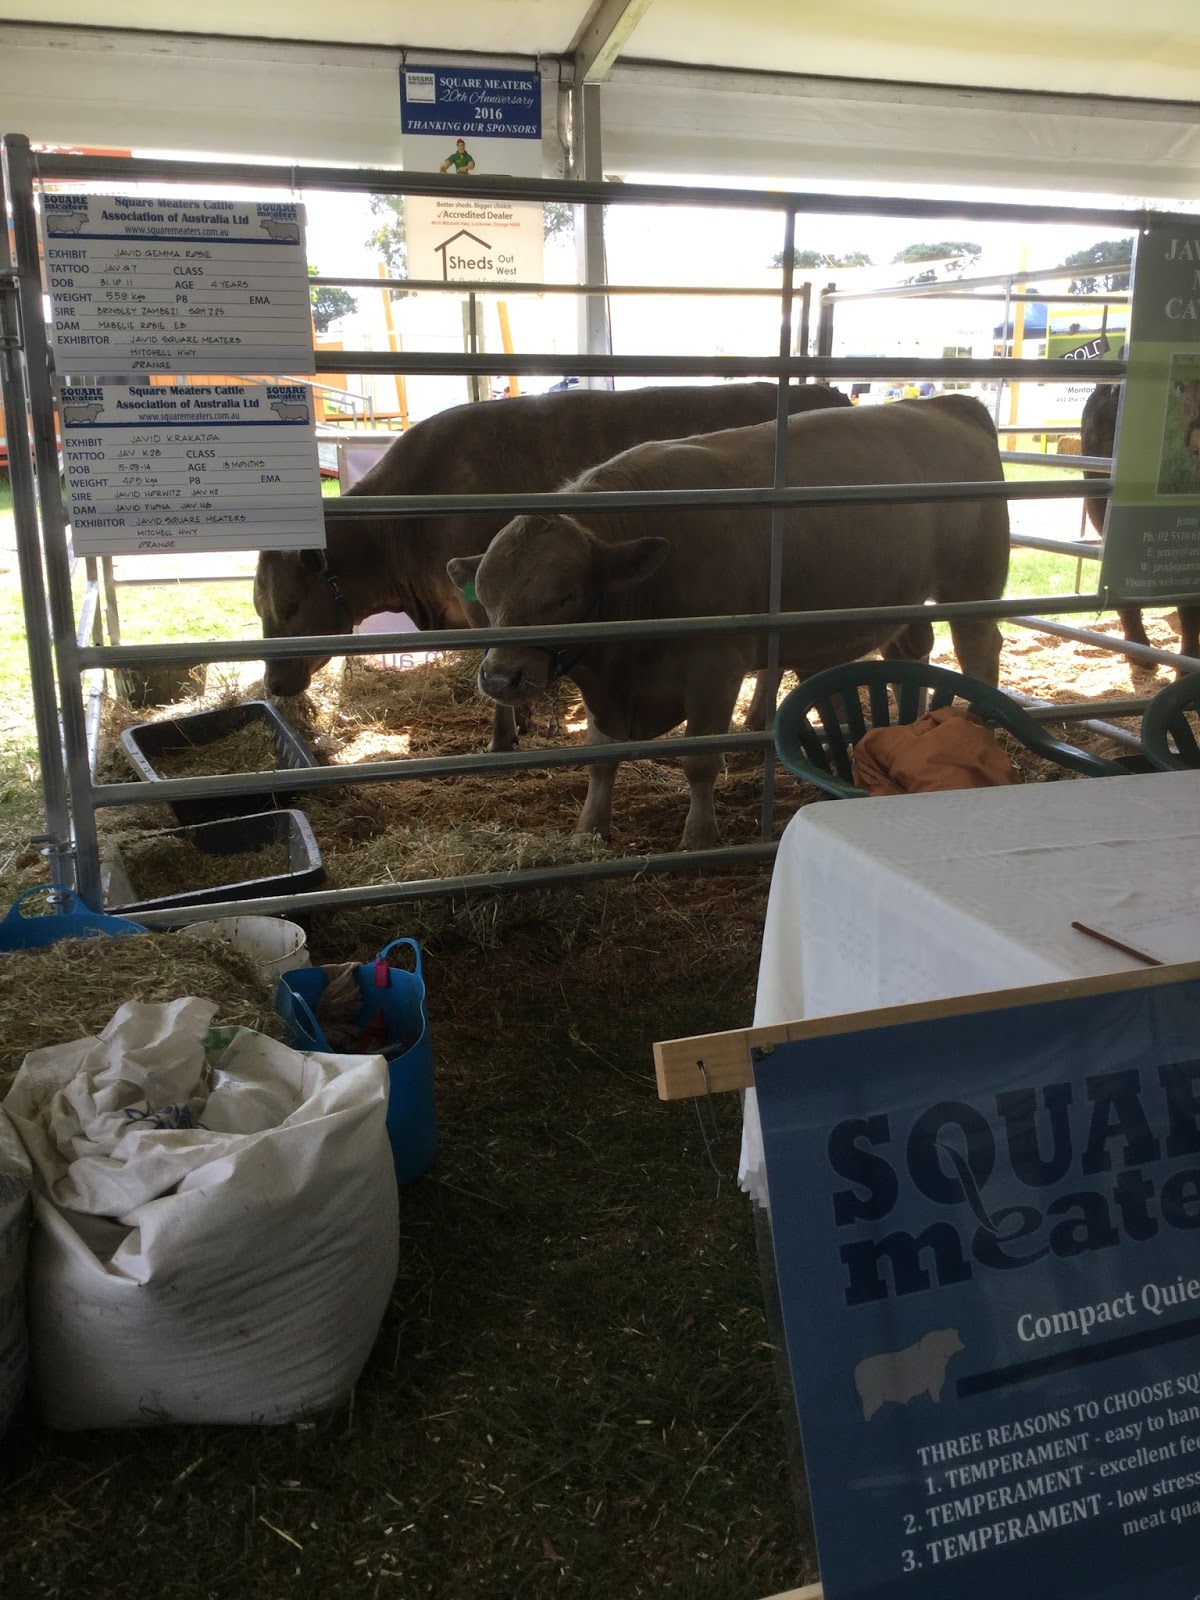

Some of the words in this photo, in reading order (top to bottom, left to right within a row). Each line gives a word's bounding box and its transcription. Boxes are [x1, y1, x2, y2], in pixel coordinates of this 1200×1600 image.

[440, 77, 482, 89] SQUARE
[484, 79, 533, 91] MEATERS
[439, 89, 468, 103] 20th
[469, 90, 534, 108] Anniversary
[474, 107, 503, 120] 2016
[407, 120, 461, 131] THANKING
[463, 122, 485, 132] OUR
[486, 123, 537, 134] SPONSORS
[44, 195, 88, 204] SQUARE
[114, 197, 155, 209] Square
[158, 199, 201, 210] Meaters
[203, 200, 235, 211] Cattle
[256, 203, 297, 212] SQUARE
[474, 202, 492, 210] Bigger
[493, 202, 512, 210] choice.
[101, 210, 165, 222] Association
[167, 211, 179, 222] of
[182, 212, 230, 225] Australia
[232, 214, 249, 225] Ltd
[442, 210, 486, 219] Accredited
[487, 212, 513, 220] Dealer
[124, 226, 229, 237] www.squaremeaters.com.au
[48, 249, 87, 259] EXHIBIT
[113, 249, 142, 258] JAVID
[144, 249, 181, 258] GEMMA
[498, 254, 514, 263] Out
[449, 256, 494, 270] Sheds
[50, 264, 90, 274] TATTOO
[104, 264, 121, 273] JAV
[173, 267, 204, 276] CLASS
[496, 266, 517, 276] West
[52, 278, 74, 288] DOB
[174, 280, 194, 290] AGE
[219, 281, 249, 289] YEARS
[53, 293, 92, 303] WEIGHT
[105, 291, 128, 301] 559
[249, 296, 270, 305] EMA
[55, 307, 76, 316] SIRE
[97, 307, 137, 315] BRINSLEY
[1165, 298, 1200, 320] CA
[56, 321, 80, 331] DAM
[140, 322, 166, 330] ROSIE
[57, 335, 110, 345] EXHIBITOR
[129, 336, 159, 344] JAVID
[161, 336, 199, 344] SQUARE
[201, 336, 241, 344] MEATERS
[130, 349, 172, 357] MITCHELL
[177, 349, 197, 357] HWY
[131, 361, 171, 370] ORANGE
[60, 387, 103, 397] SQUARE
[128, 386, 168, 398] Square
[170, 386, 211, 396] Meaters
[214, 385, 245, 395] Cattle
[266, 386, 306, 395] SQUARE
[116, 400, 178, 410] Association
[180, 399, 191, 409] of
[193, 399, 240, 409] Australia
[243, 399, 260, 409] Ltd
[138, 412, 240, 422] www.squaremeaters.com.au
[65, 438, 102, 448] EXHIBIT
[130, 434, 161, 444] JAVID
[166, 433, 221, 443] KRAKATOA
[67, 451, 105, 461] TATTOO
[116, 449, 136, 458] JAV
[186, 450, 216, 459] CLASS
[187, 462, 207, 472] AGE
[231, 460, 265, 469] MONTHS
[68, 465, 90, 475] DOB
[69, 478, 108, 488] WEIGHT
[260, 474, 281, 484] EMA
[71, 491, 92, 501] SIRE
[113, 490, 140, 499] JAVID
[190, 489, 208, 497] JAV
[73, 505, 97, 515] DAM
[114, 503, 140, 513] JAVID
[145, 503, 171, 512] FIONA
[180, 502, 198, 510] JAV
[75, 518, 125, 529] EXHIBITOR
[135, 516, 162, 526] JAVID
[164, 516, 201, 525] SQUARE
[205, 515, 247, 524] MEATERS
[137, 528, 173, 537] MITCHELL
[178, 528, 197, 536] HWY
[138, 540, 176, 549] ORANGE
[1017, 1291, 1137, 1342] Compact
[1141, 1275, 1200, 1315] Quie
[916, 1433, 983, 1467] THREE
[987, 1408, 1072, 1448] REASONS
[1074, 1401, 1100, 1424] TO
[1103, 1380, 1174, 1414] CHOOSE
[1176, 1372, 1200, 1395] SQ
[925, 1477, 942, 1495] 1.
[945, 1432, 1090, 1491] TEMPERAMENT
[1104, 1420, 1142, 1445] easy
[1147, 1416, 1164, 1432] to
[1167, 1404, 1200, 1426] han
[903, 1515, 923, 1535] 2.
[925, 1464, 1085, 1529] TEMPERAMENT
[1099, 1439, 1178, 1478] excellent
[1122, 1508, 1167, 1536] meat
[901, 1549, 923, 1572] 3.
[926, 1493, 1101, 1565] TEMPERAMENT
[1117, 1486, 1148, 1508] low
